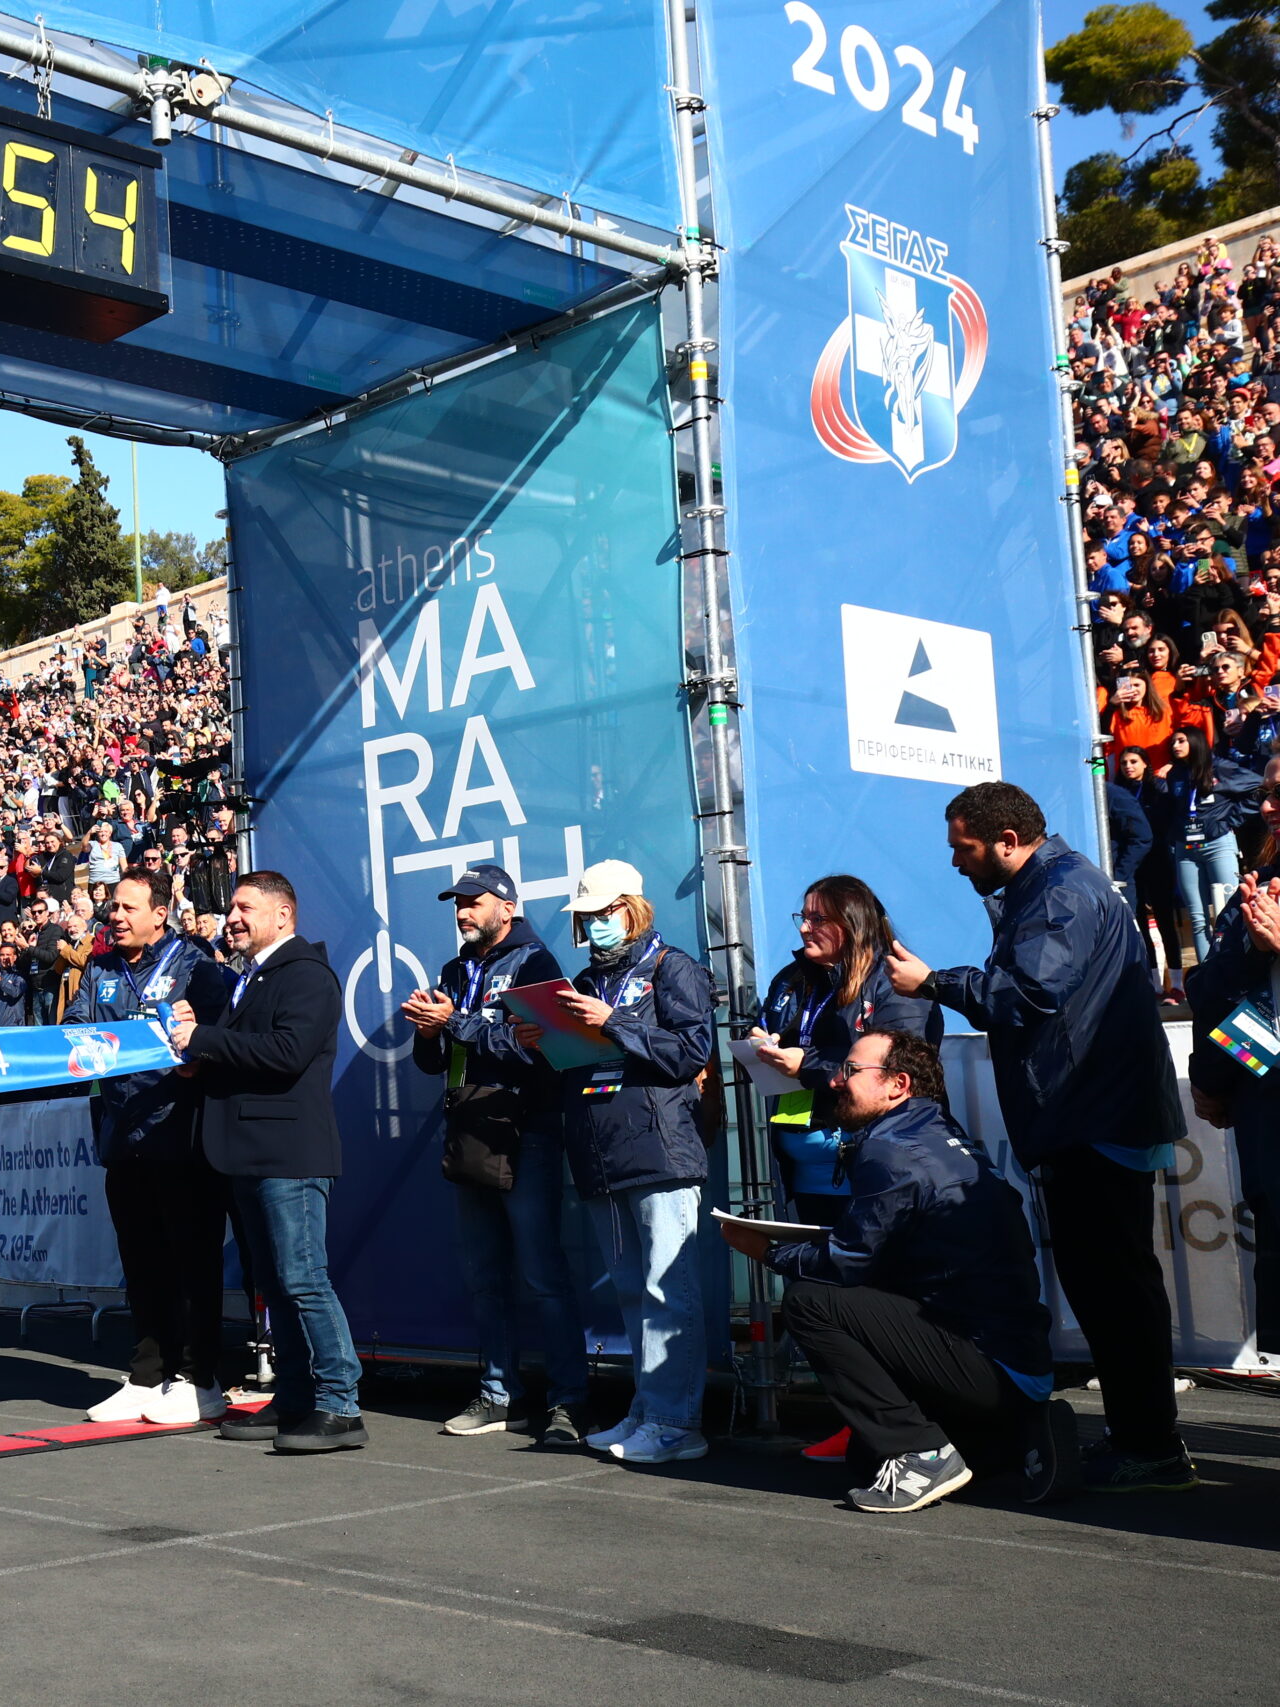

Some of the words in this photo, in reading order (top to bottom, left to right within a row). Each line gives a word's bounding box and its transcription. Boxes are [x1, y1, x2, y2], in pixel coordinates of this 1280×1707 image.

[783, 0, 979, 156] 2024
[844, 203, 949, 281] ΣΕΓΑΣ
[356, 528, 497, 613] athens
[857, 738, 937, 764] ΠΕΡΙΦΕΡΕΙΑ
[941, 752, 994, 773] ΑΤΤΙΚΗΣ
[57, 1140, 71, 1168] to
